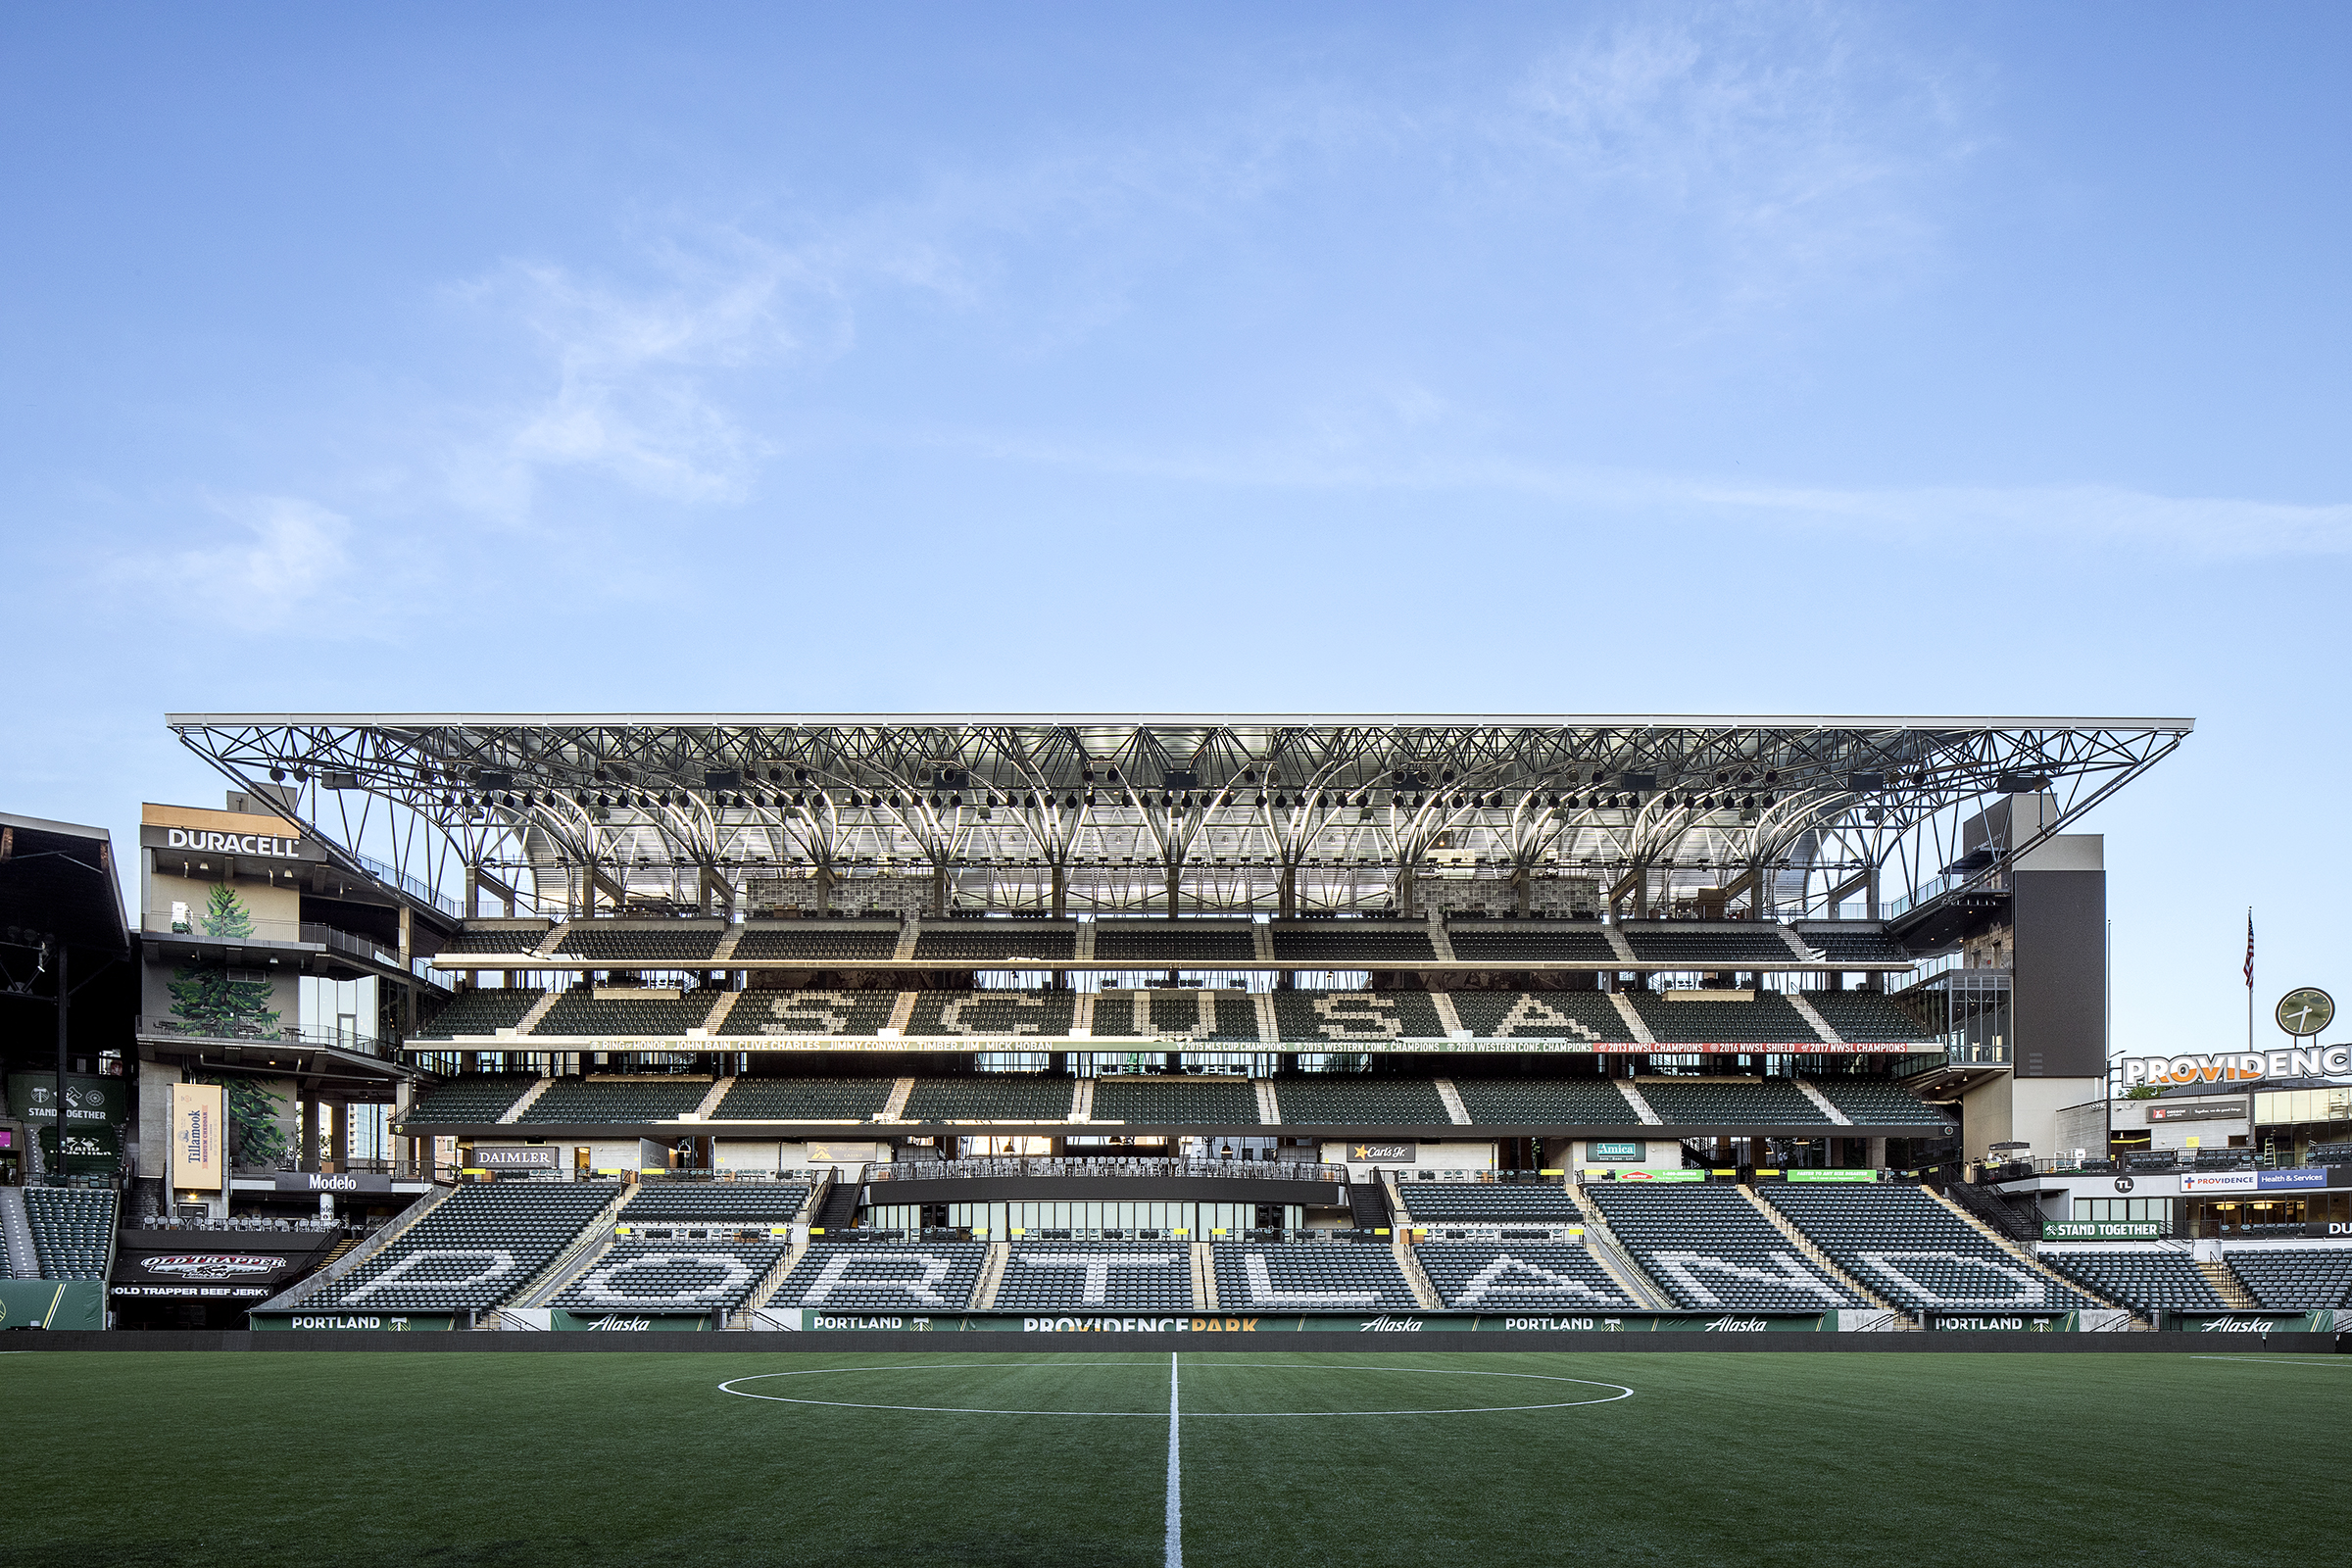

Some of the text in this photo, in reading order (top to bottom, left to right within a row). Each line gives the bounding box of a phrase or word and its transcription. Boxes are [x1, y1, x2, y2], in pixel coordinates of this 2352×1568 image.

[169, 829, 299, 858] DURACELL
[602, 1041, 624, 1051] RING
[633, 1041, 666, 1051] HONOR
[674, 1041, 731, 1051] JOHN BAIN
[738, 1041, 820, 1051] CLIVE CHARLES
[828, 1041, 909, 1051] JIMMY CONWAY
[917, 1041, 979, 1051] TIMBER JIM
[986, 1041, 1053, 1051] MICK HOBAN
[1186, 1042, 1287, 1052] 2015 MLS CUP CHAMPIONS
[1303, 1042, 1440, 1052] 2015 WESTERN CONF. CHAMPIONS
[1456, 1043, 1592, 1052] 2018 WESTERN CONF. CHAMPIONS
[1608, 1043, 1703, 1053] 2013 NWSL CHAMPIONS
[1719, 1043, 1794, 1053] 2016 NWSL SHIELD
[1810, 1043, 1906, 1053] 2017 NWSL CHAMPIONS
[2124, 1044, 2352, 1086] PROVIDENC
[28, 1107, 106, 1119] STAND OGETHER
[188, 1110, 200, 1163] Tillamook
[1367, 1147, 1392, 1157] Carl's
[1598, 1143, 1634, 1153] Amica
[478, 1152, 551, 1163] DAIMLER
[309, 1174, 357, 1190] Modelo
[2197, 1176, 2254, 1185] PROVIDENCE
[2293, 1173, 2323, 1182] Services
[2116, 1180, 2132, 1189] TL
[2058, 1224, 2158, 1236] STAND TOGETHER
[143, 1255, 286, 1268] OLD TRAPPER
[142, 1287, 197, 1296] TRAPPER
[292, 1316, 380, 1329] PORTLAND
[587, 1313, 651, 1332] Alaska
[813, 1316, 903, 1329] PORTLAND
[1359, 1314, 1423, 1332] Alaska
[1505, 1317, 1593, 1330] PORTLAND
[1704, 1314, 1767, 1332] Alaska
[1936, 1317, 2023, 1330] PORTLAND
[2201, 1314, 2274, 1332] Alaska
